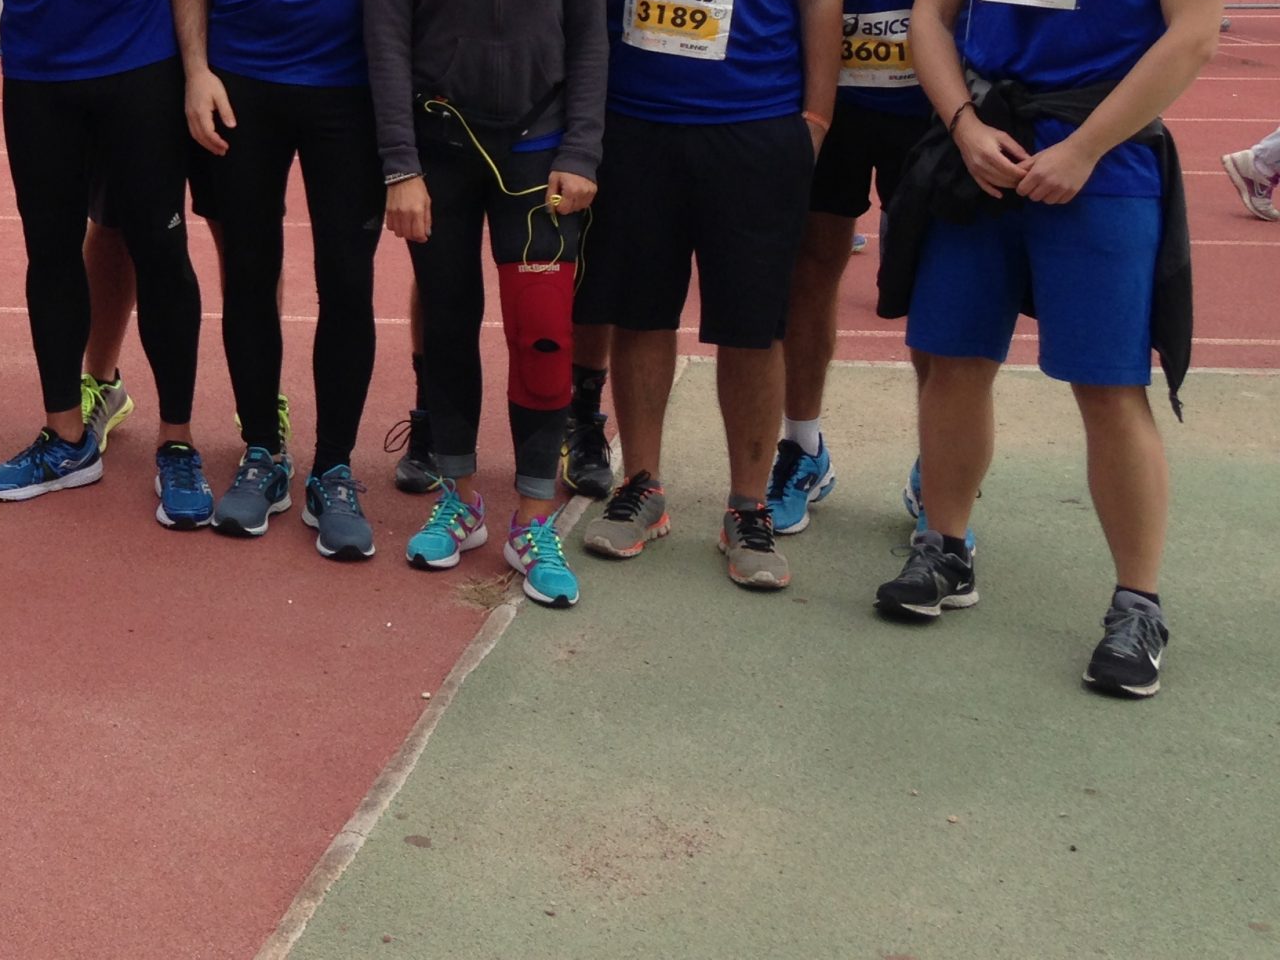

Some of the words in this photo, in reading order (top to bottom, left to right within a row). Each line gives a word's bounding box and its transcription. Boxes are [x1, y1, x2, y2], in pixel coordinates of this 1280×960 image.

[637, 0, 708, 30] 3189
[861, 17, 910, 37] asics
[841, 40, 906, 62] 3601
